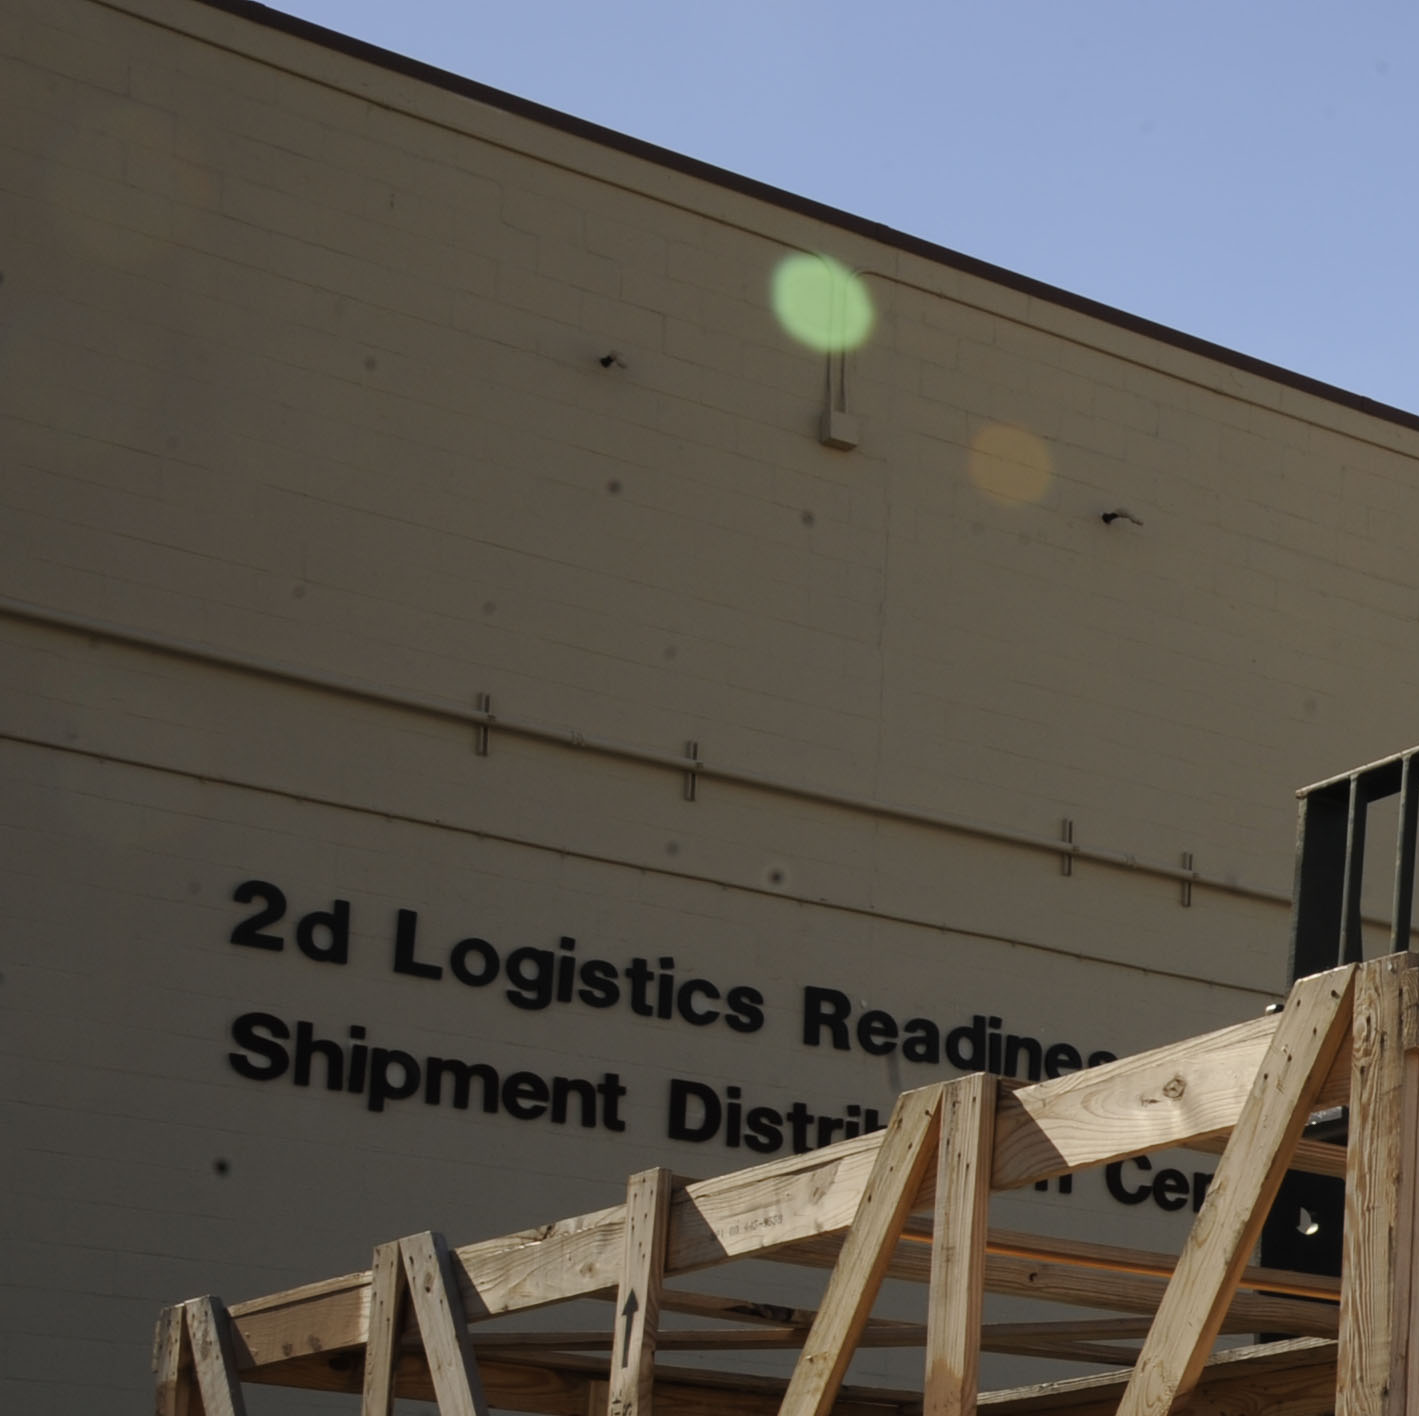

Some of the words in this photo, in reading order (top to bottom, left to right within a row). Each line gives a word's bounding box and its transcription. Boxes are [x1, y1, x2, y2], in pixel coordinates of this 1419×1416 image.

[229, 879, 350, 964] 2d
[393, 909, 765, 1034] Logistics
[227, 1011, 626, 1131] Shipment
